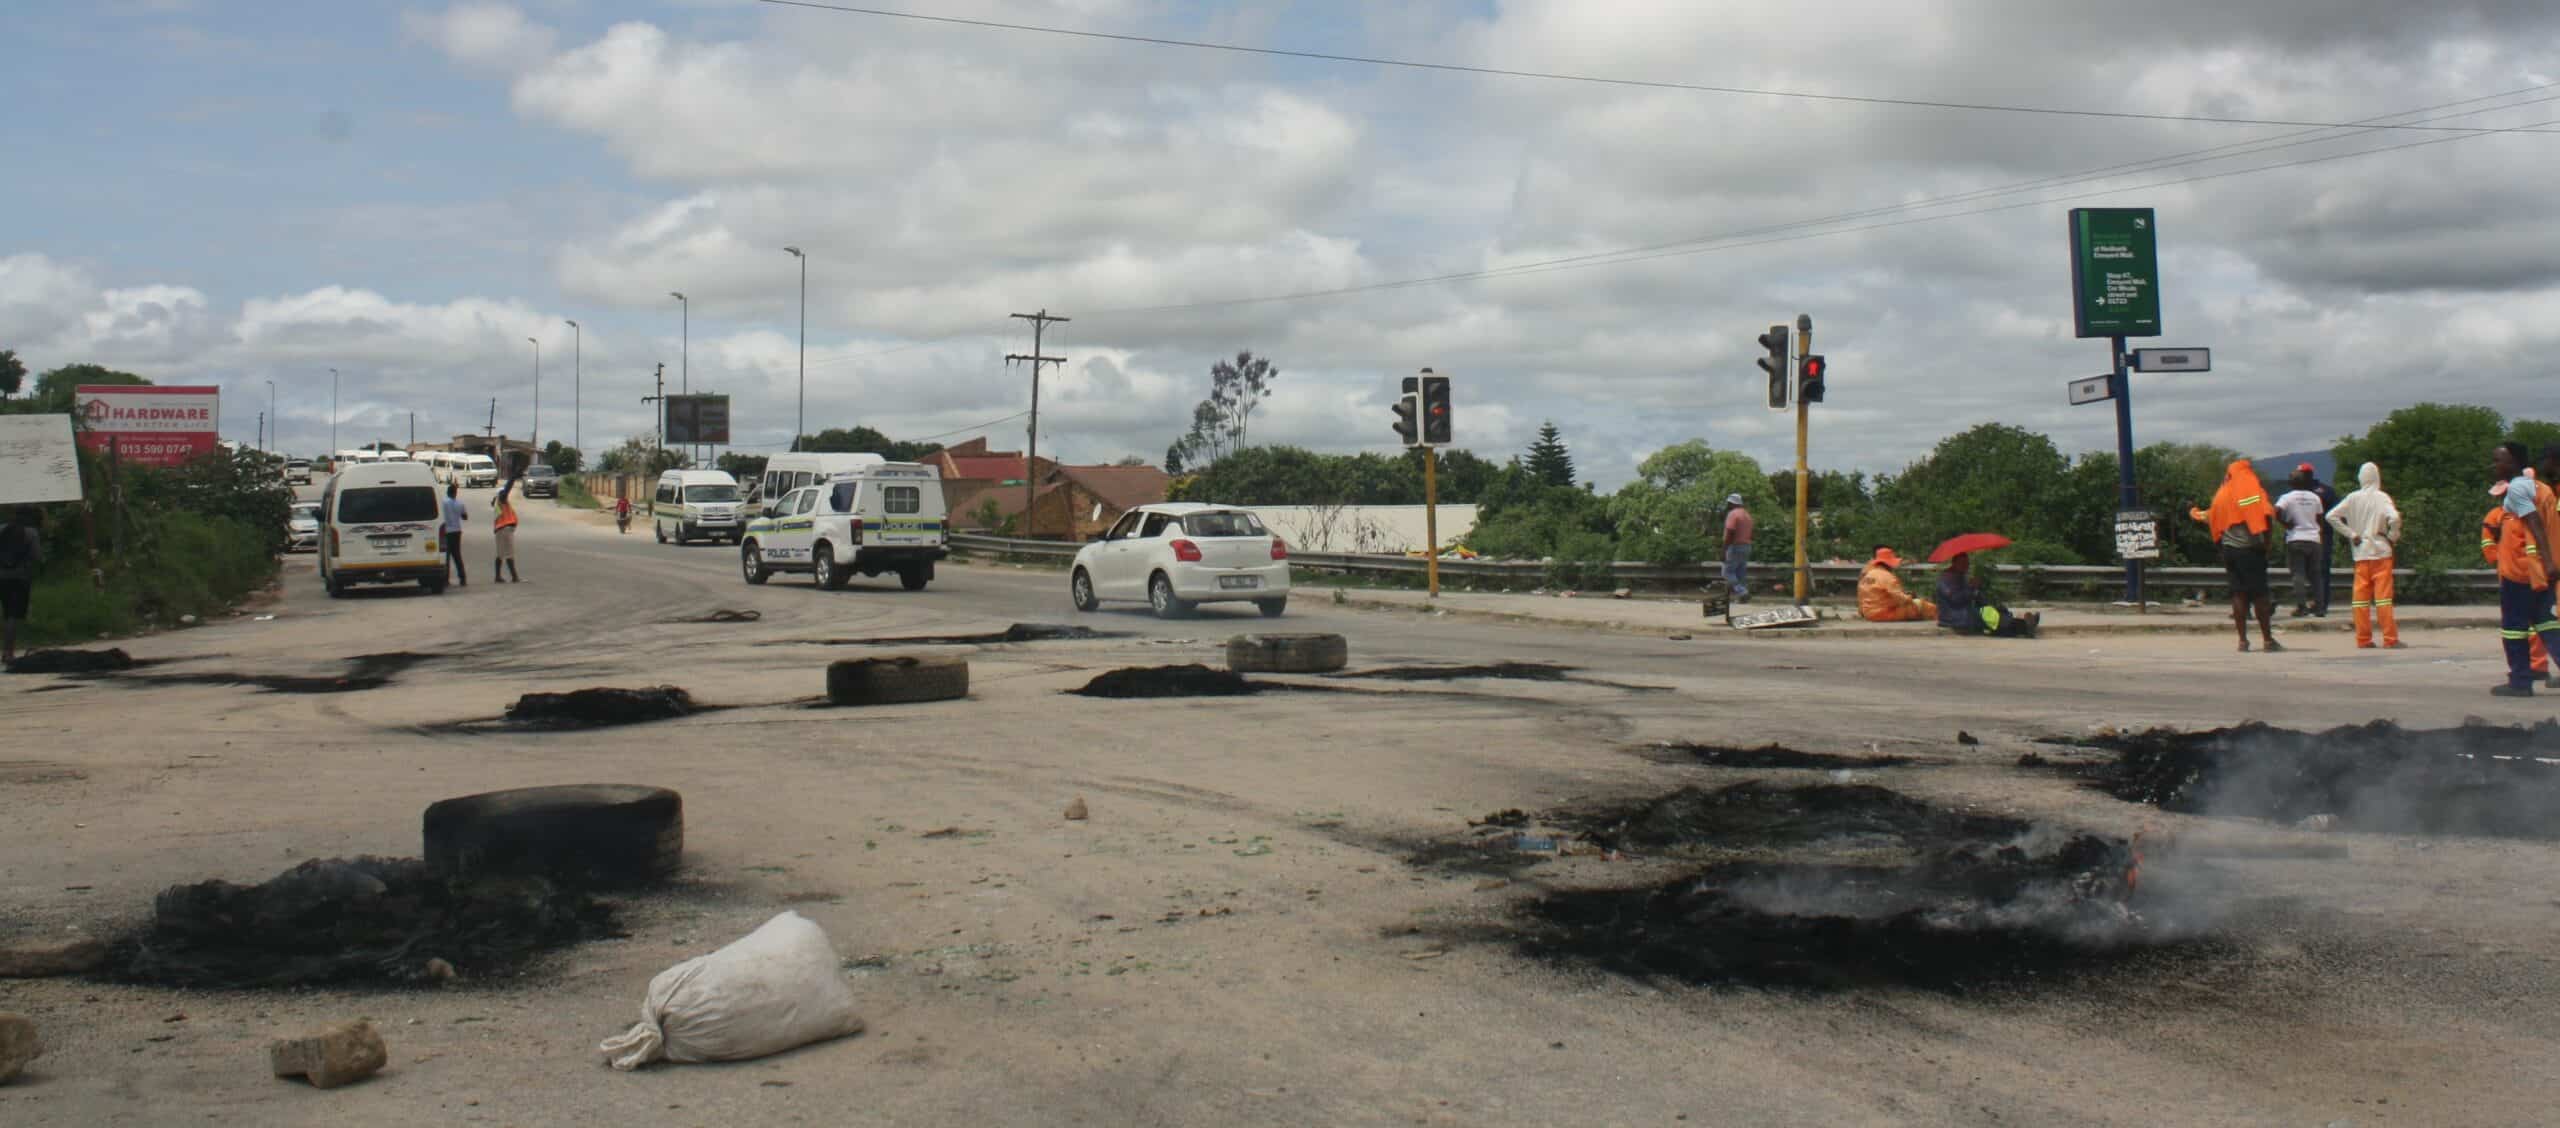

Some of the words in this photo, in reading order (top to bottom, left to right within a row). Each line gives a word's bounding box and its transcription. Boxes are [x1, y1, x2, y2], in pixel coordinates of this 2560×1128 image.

[113, 408, 209, 419] HARDWARE
[120, 443, 141, 454] 013
[767, 548, 791, 558] POLICE
